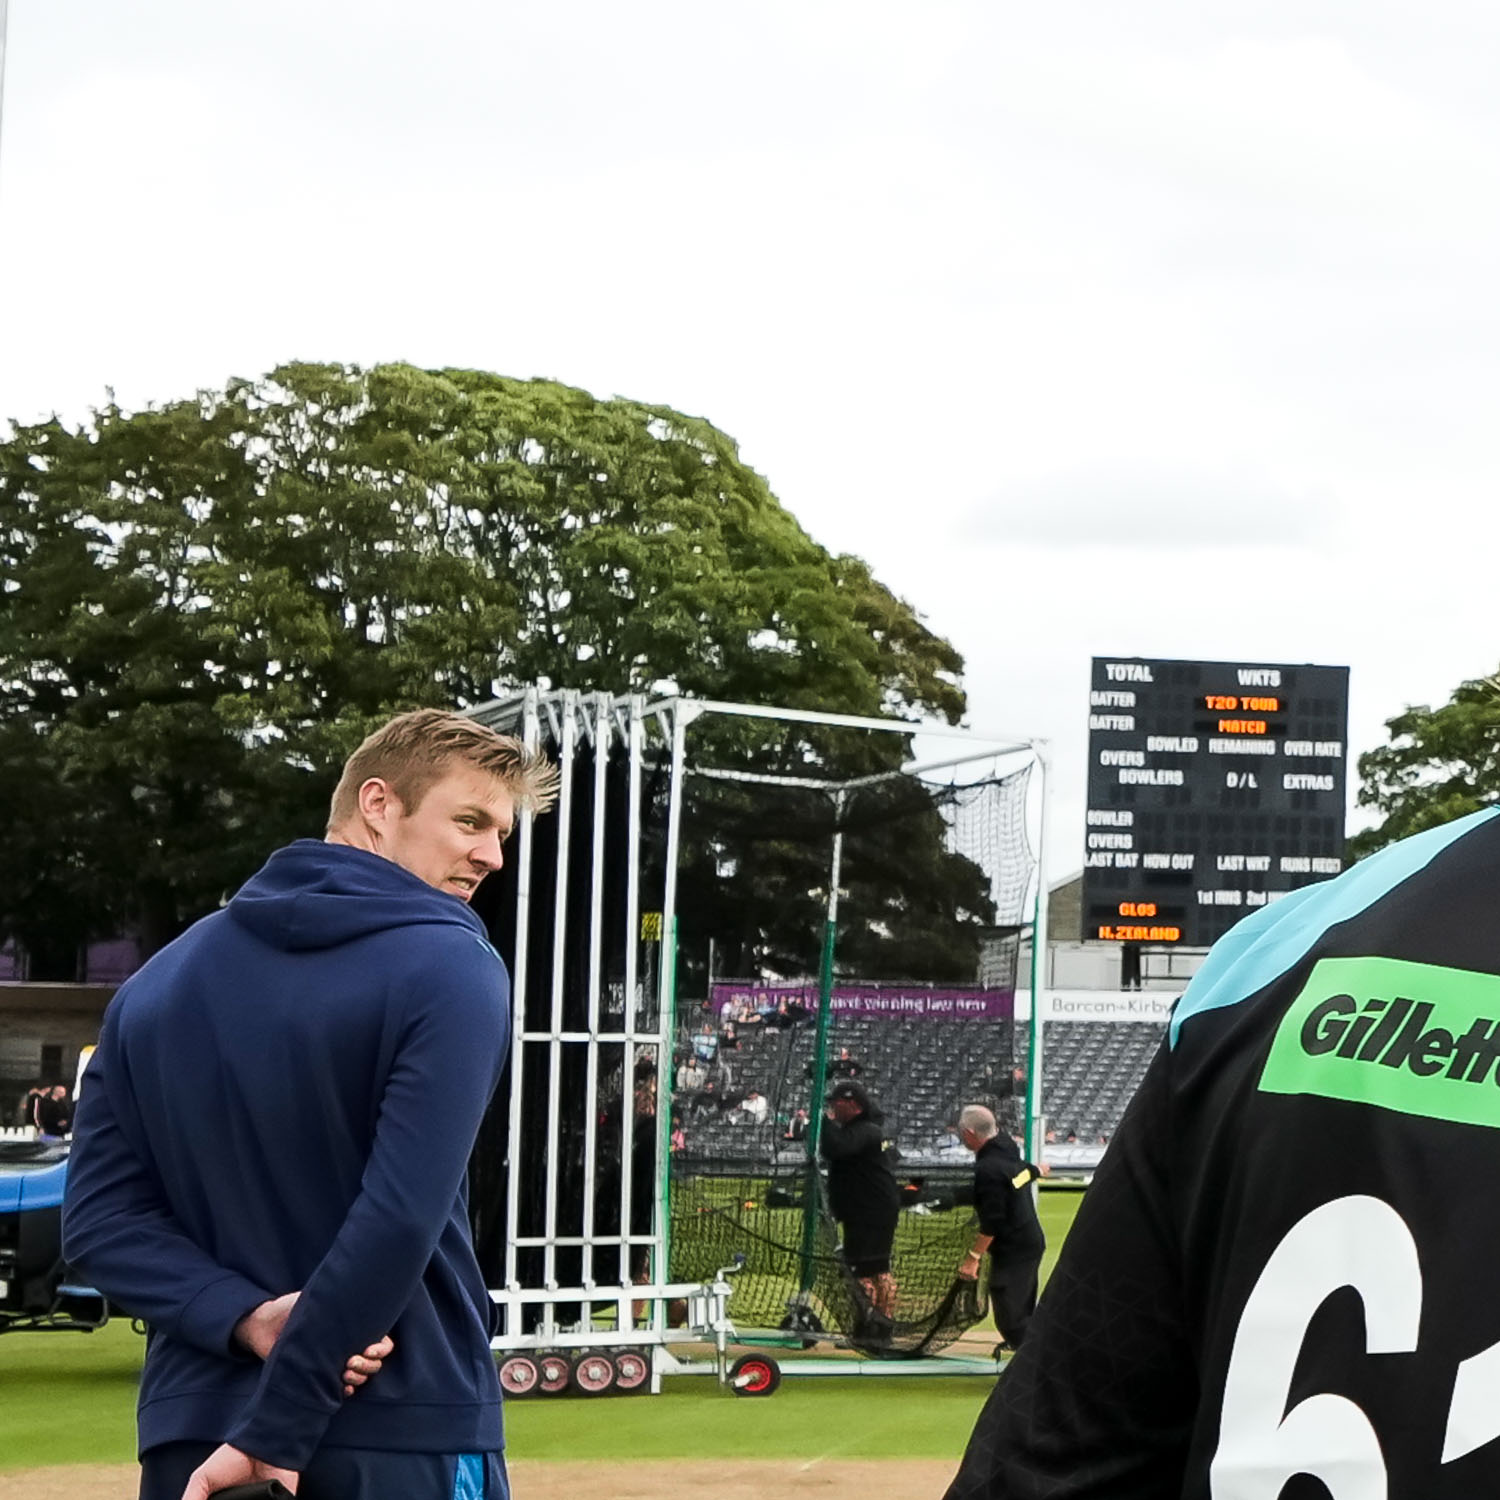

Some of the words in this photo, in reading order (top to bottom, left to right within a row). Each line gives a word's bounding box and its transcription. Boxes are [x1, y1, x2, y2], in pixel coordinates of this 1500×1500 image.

[1106, 664, 1154, 682] TOTAL
[1237, 669, 1281, 687] WKTS
[1090, 691, 1136, 707] BATTER
[1205, 696, 1237, 710] T20
[1241, 697, 1278, 711] TOUR
[1089, 715, 1135, 731] BATTER
[1218, 720, 1266, 734] MATCH
[1147, 736, 1198, 752] BOWLED
[1208, 739, 1276, 755] REMAINING
[1284, 741, 1313, 756] OVER
[1314, 742, 1342, 758] RATE
[1100, 751, 1145, 766] OVERS
[1119, 770, 1184, 786] BOWLERS
[1283, 774, 1334, 790] EXTRAS
[1087, 810, 1133, 826] BOWLER
[1088, 833, 1133, 849] OVERS
[1084, 852, 1113, 868] LAST
[1115, 853, 1138, 868] BAT
[1143, 854, 1170, 869] HOW
[1172, 855, 1194, 870] OUT
[1217, 855, 1245, 871] LAST
[1246, 856, 1271, 871] WKT
[1119, 903, 1157, 917] GLOS
